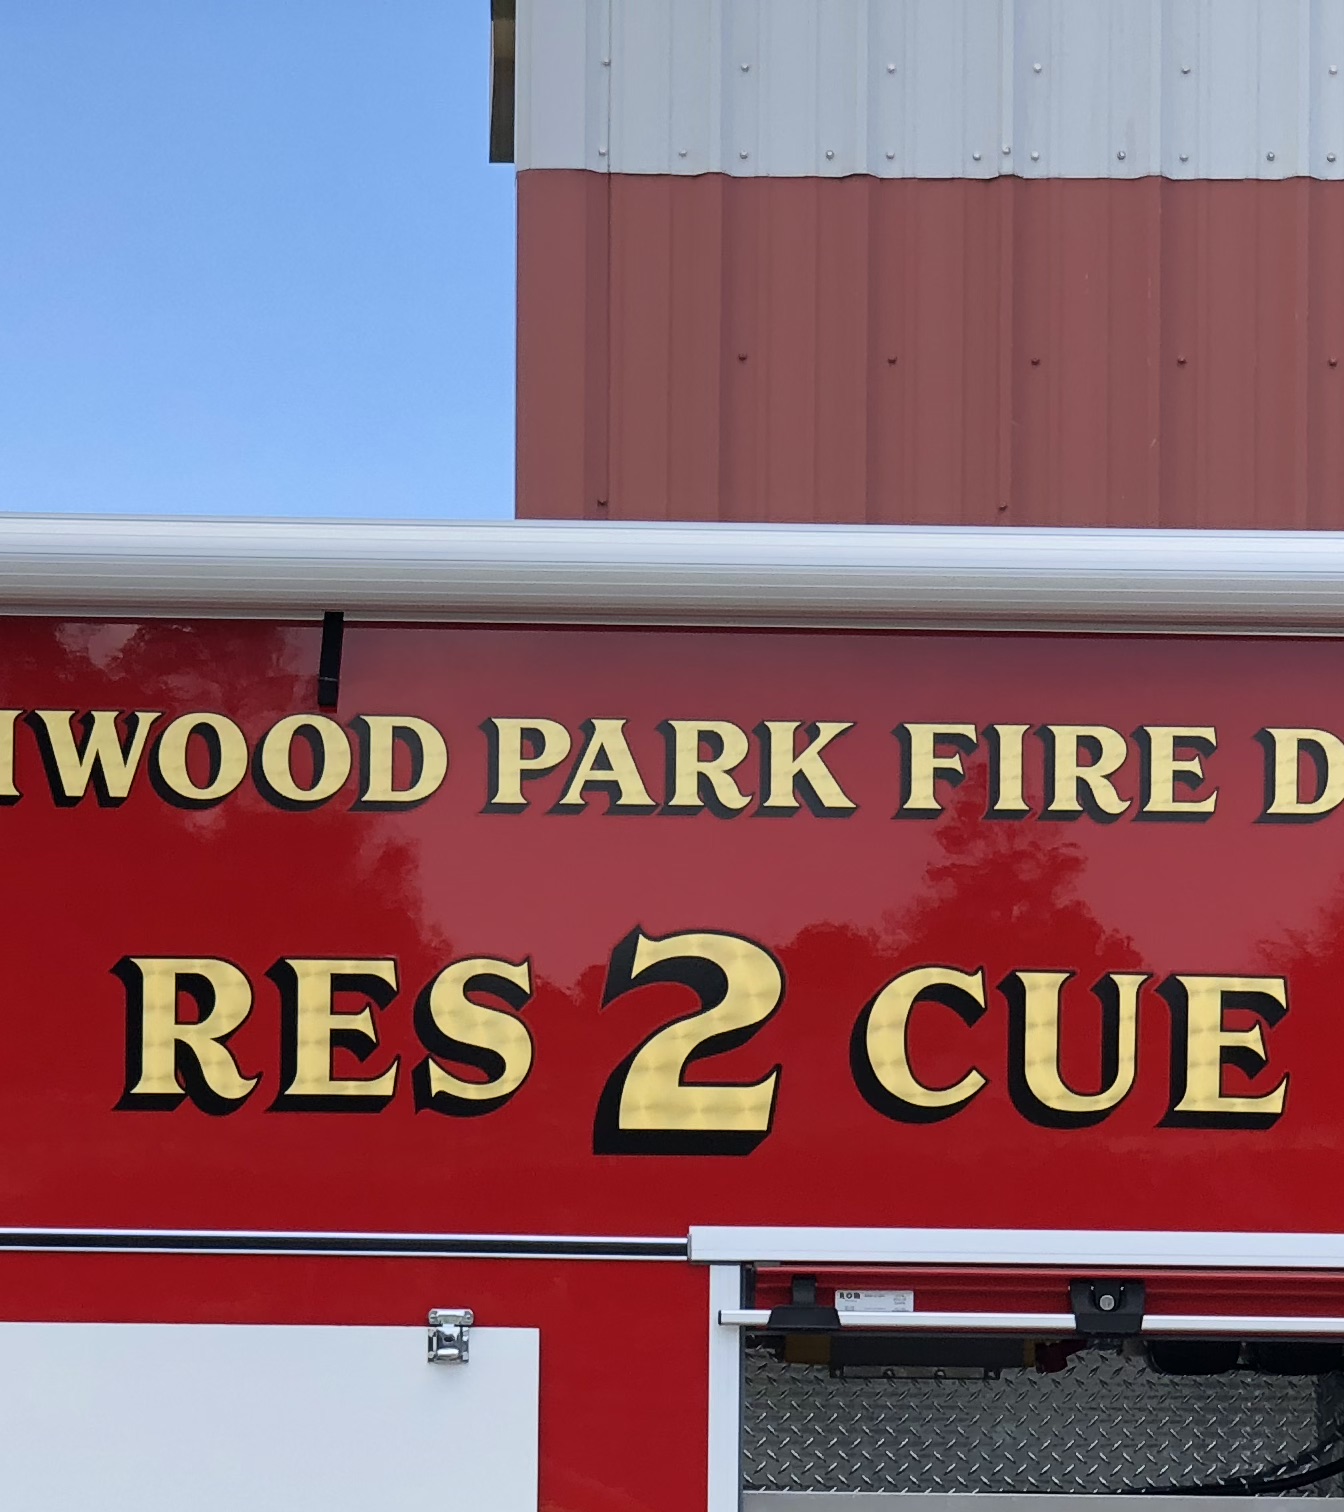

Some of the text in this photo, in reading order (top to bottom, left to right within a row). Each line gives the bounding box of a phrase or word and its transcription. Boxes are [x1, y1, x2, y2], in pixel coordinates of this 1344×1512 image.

[478, 716, 858, 820] PARK
[890, 721, 1219, 825] FIRE
[108, 924, 1292, 1157] RES 2 CUE
